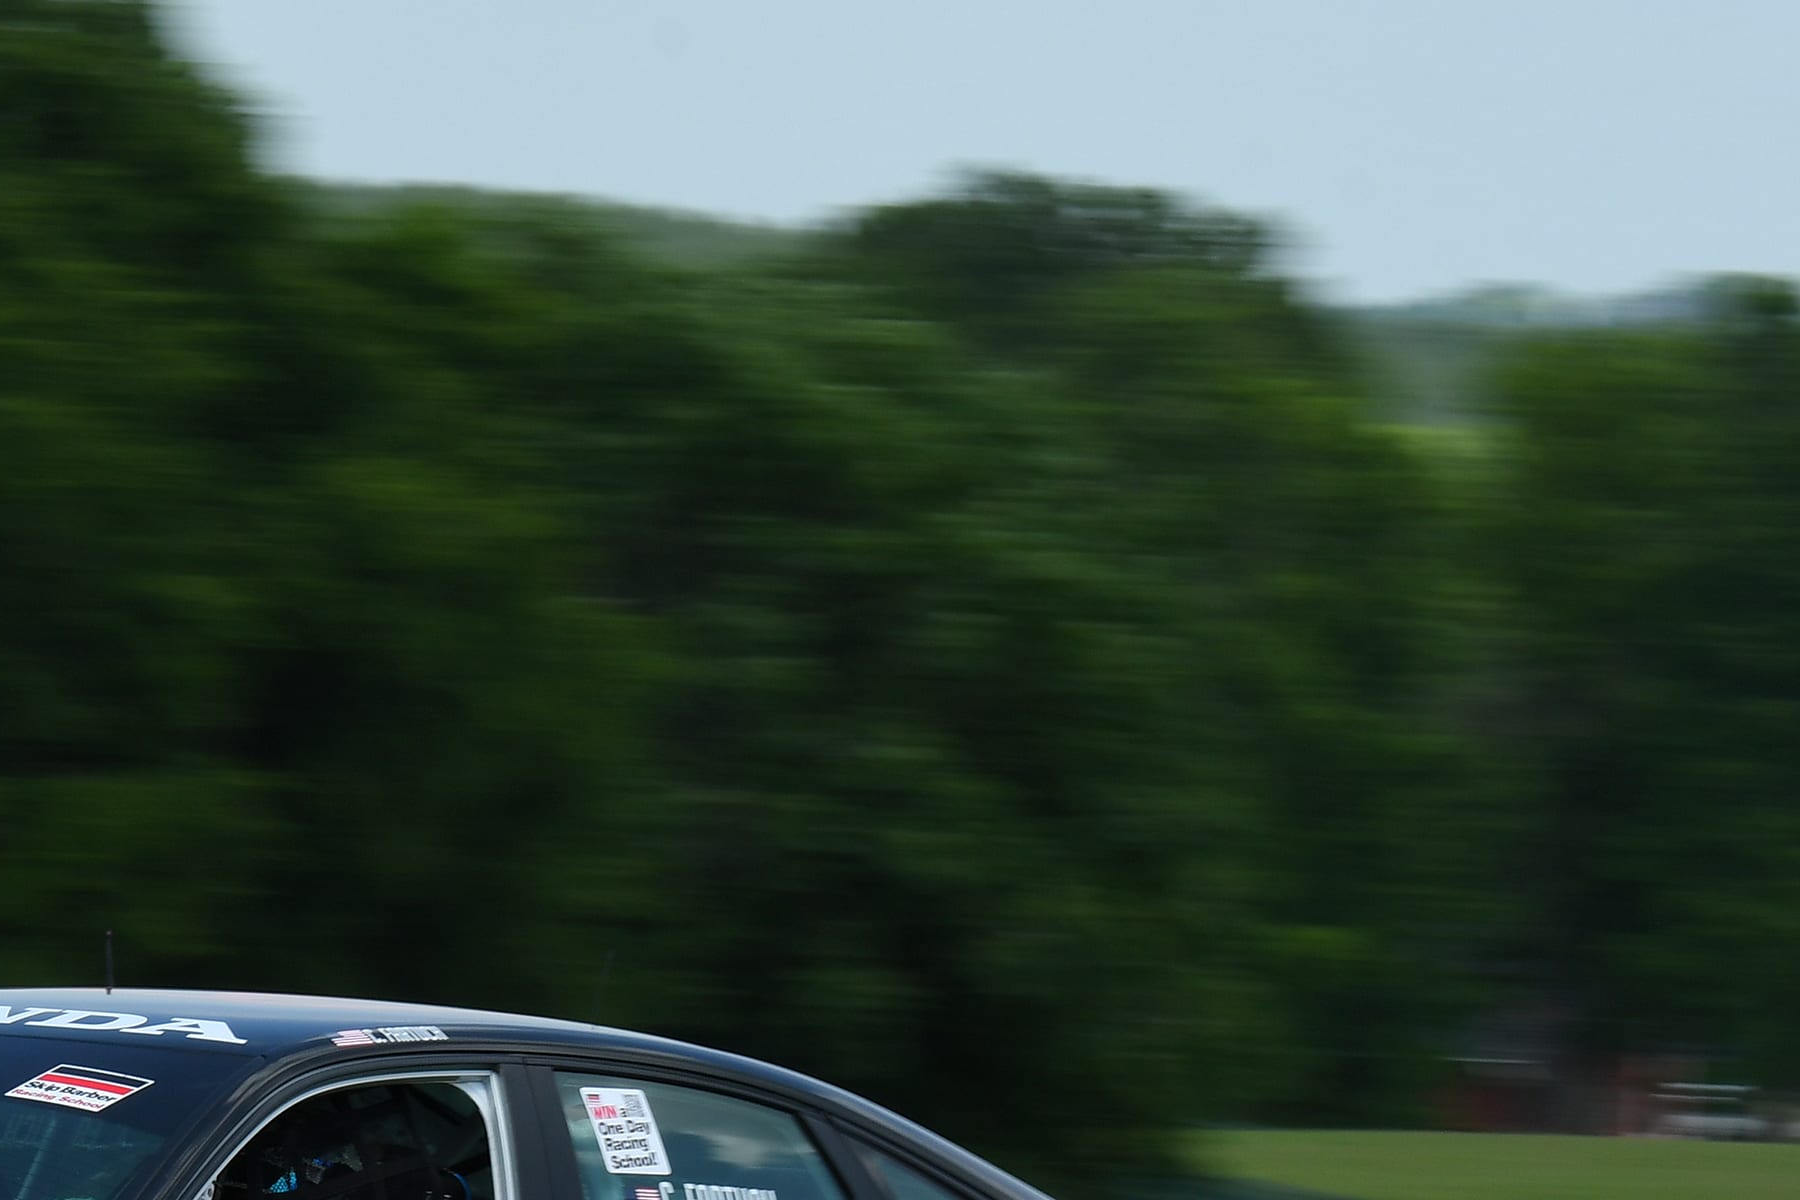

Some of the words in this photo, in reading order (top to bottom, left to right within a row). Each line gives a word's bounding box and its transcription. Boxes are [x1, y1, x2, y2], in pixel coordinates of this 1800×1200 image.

[12, 1089, 57, 1101] Racing
[59, 1095, 105, 1110] School
[24, 1081, 60, 1093] Skip
[60, 1085, 119, 1102] Barber
[598, 1121, 625, 1136] One
[626, 1119, 650, 1136] Day
[605, 1137, 649, 1152] Racing
[611, 1153, 659, 1169] School!
